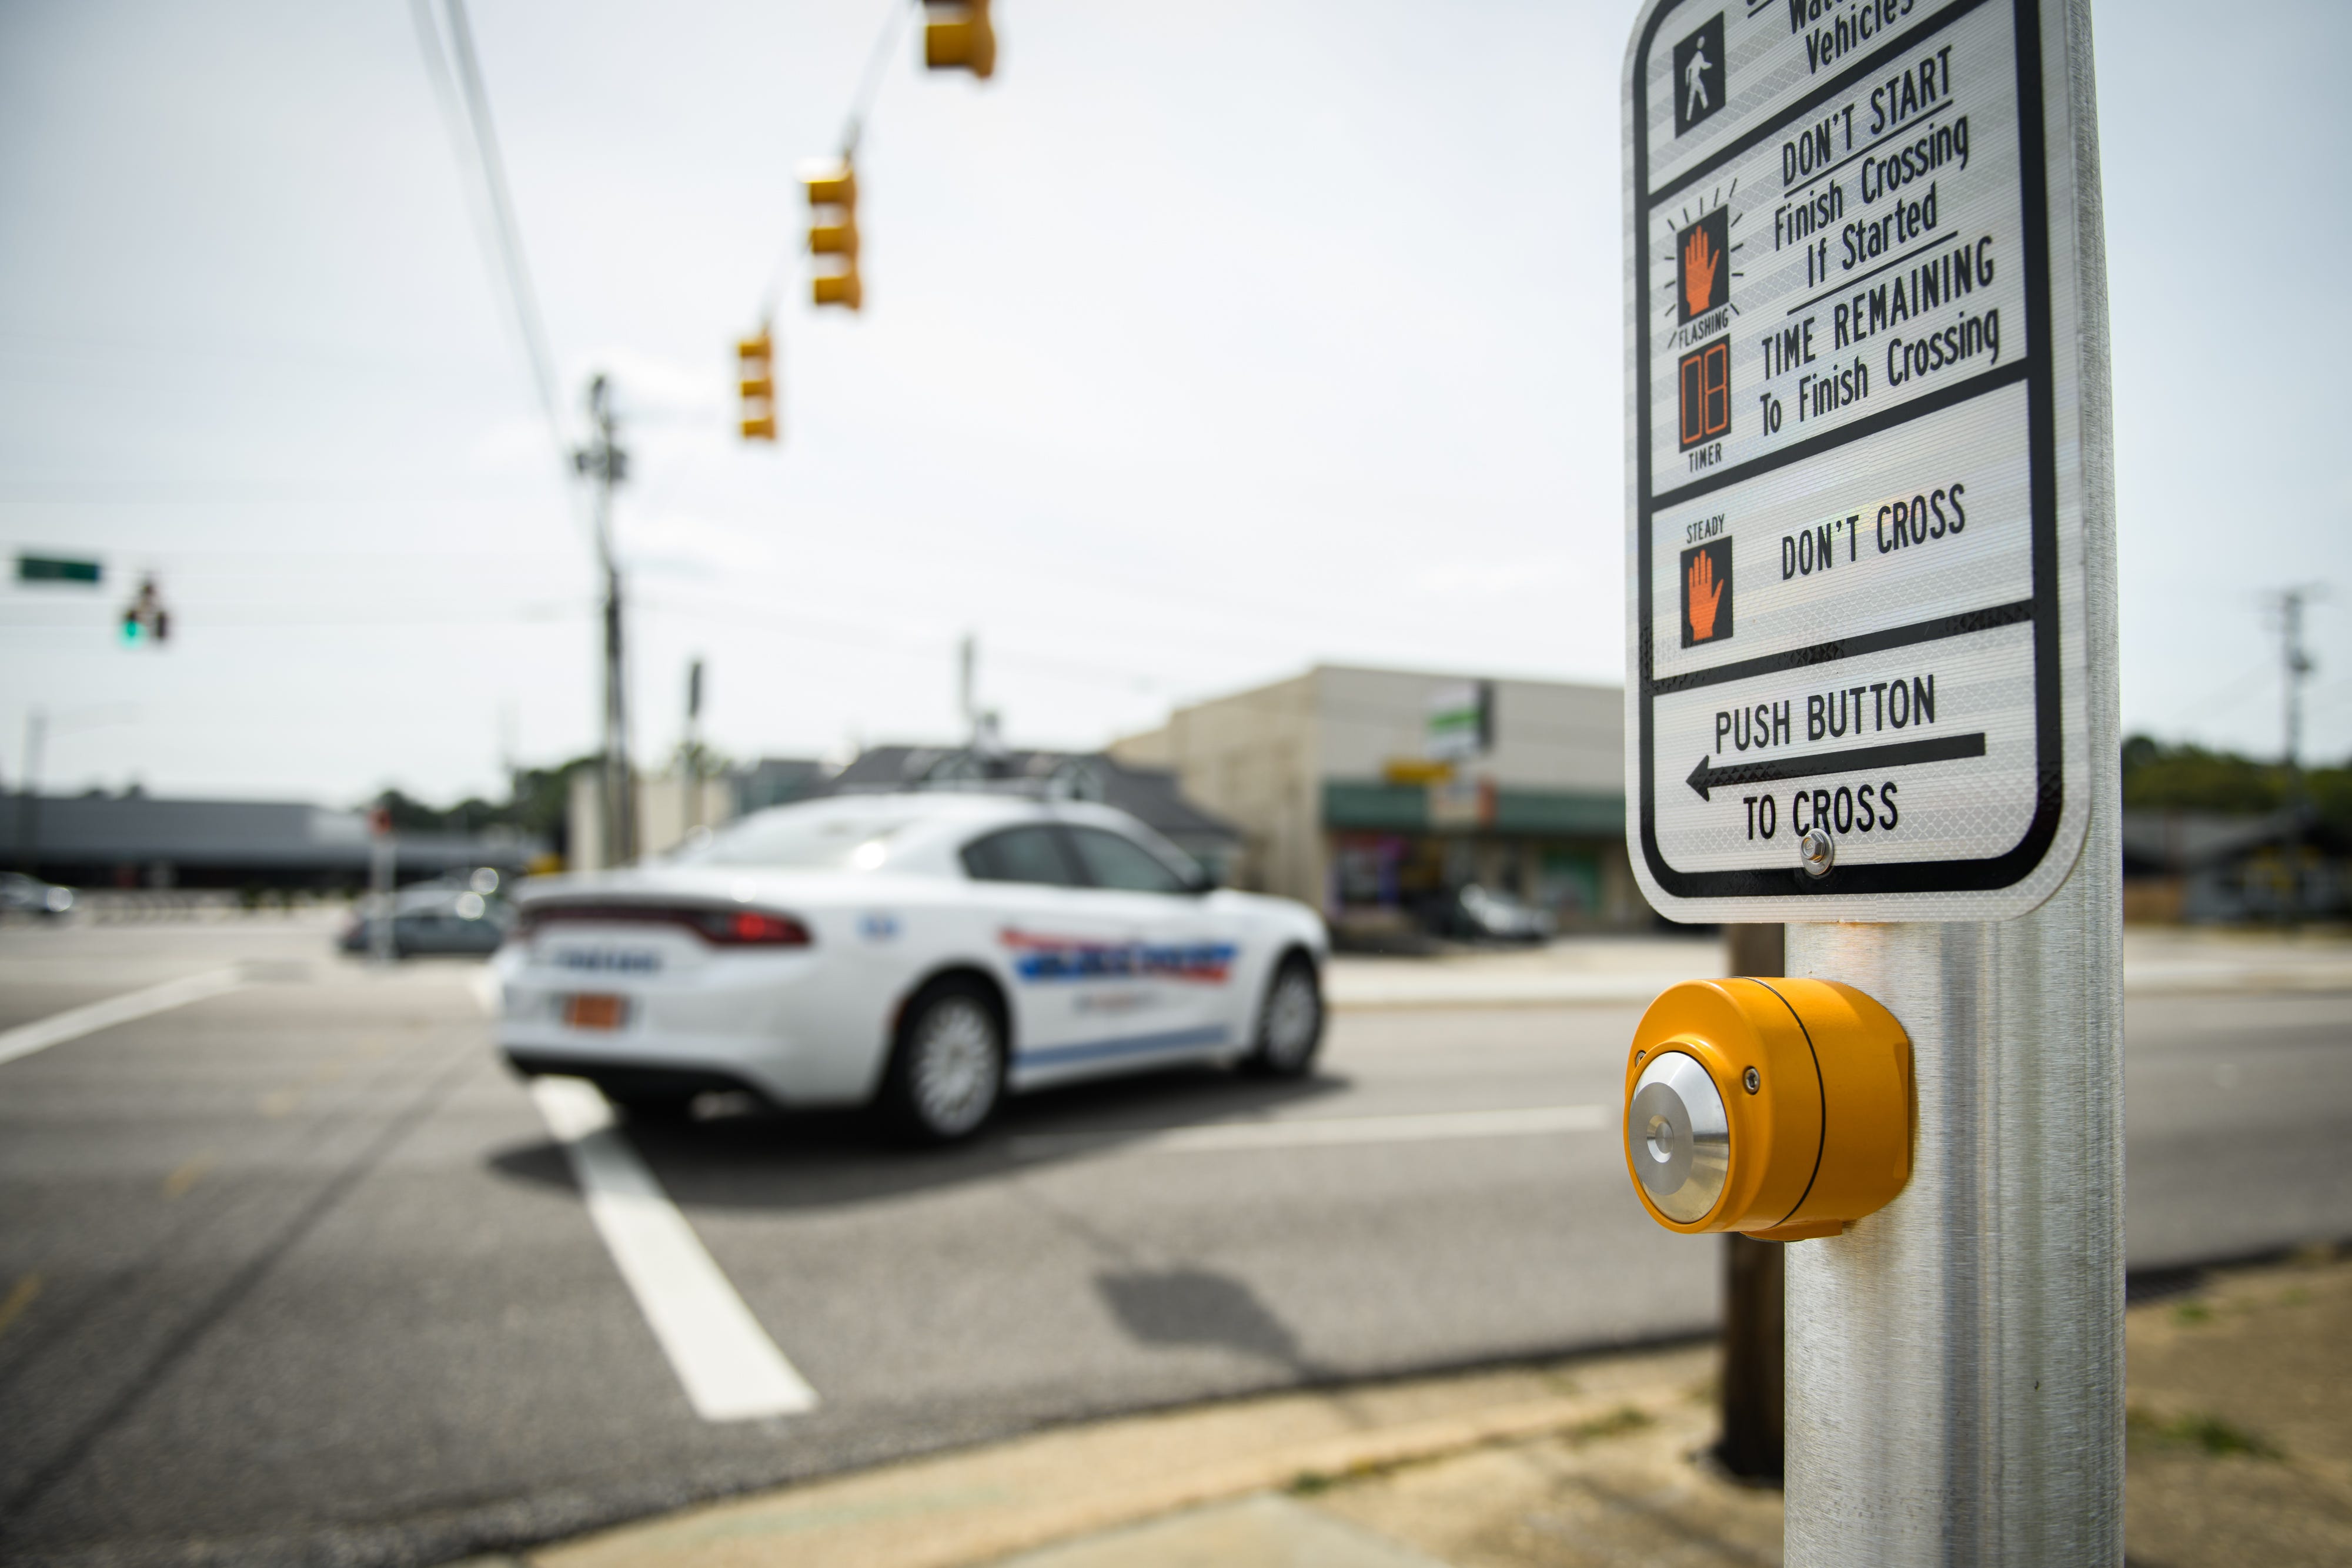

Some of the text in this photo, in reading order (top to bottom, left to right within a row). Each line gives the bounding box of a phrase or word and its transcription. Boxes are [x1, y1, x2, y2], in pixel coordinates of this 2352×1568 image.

[1782, 44, 1953, 188] DON'T START
[1775, 114, 1970, 251] Finish Crossing
[1807, 180, 1938, 289] If Started
[1679, 307, 1729, 349] FLASHING
[1761, 235, 1994, 380] TIME REMAINING
[1760, 308, 1999, 437] To Finish Crossing
[1689, 442, 1722, 473] TIMER
[1686, 513, 1725, 544] STEADY
[1782, 483, 1966, 580] DON'T CROSS
[1715, 674, 1936, 754] PUSH BUTTON
[1743, 781, 1899, 840] TO CROSS
